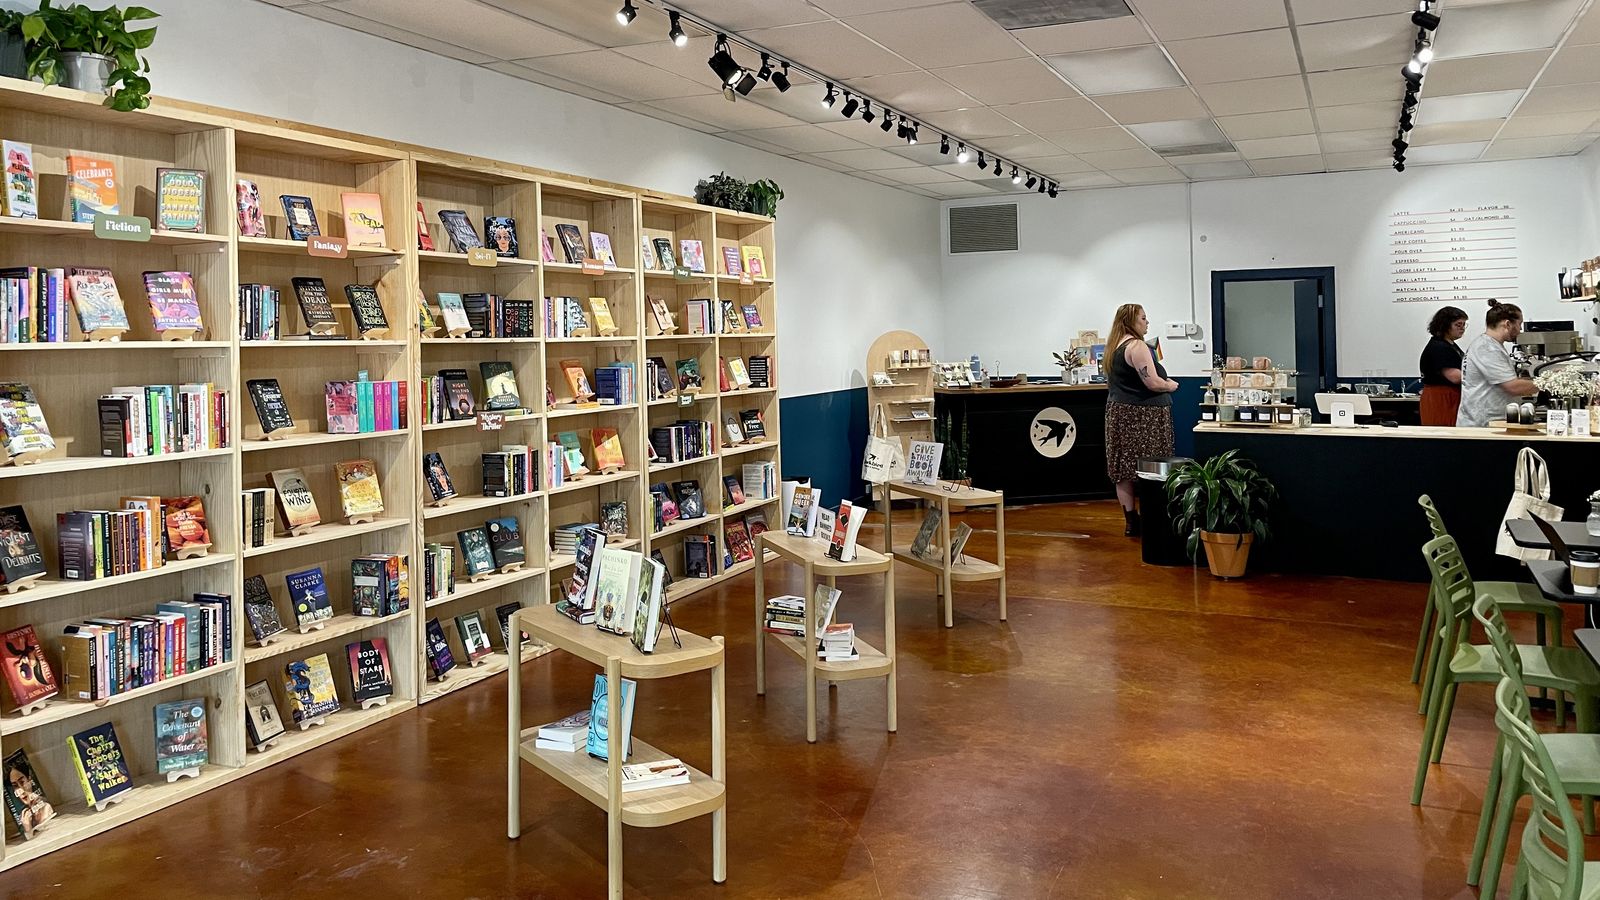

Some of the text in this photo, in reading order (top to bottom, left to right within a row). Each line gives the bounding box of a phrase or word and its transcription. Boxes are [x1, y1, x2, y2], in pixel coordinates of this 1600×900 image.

[76, 168, 113, 179] CELEBRANTS
[162, 188, 200, 197] DIGGERS
[106, 220, 141, 232] Fiction
[314, 240, 342, 253] Fantasy
[71, 268, 84, 277] DEEP
[76, 280, 87, 291] RED
[915, 444, 935, 454] GIVE
[283, 488, 308, 497] FOURTH
[286, 495, 311, 506] WING
[820, 521, 832, 532] BANNED
[493, 533, 519, 542] CLUB
[2, 552, 41, 568] DELIGHTS
[602, 554, 628, 565] PACHINKO
[291, 573, 322, 585] SUSANNA
[295, 579, 320, 589] CLARKE
[358, 649, 379, 658] BODY
[360, 665, 383, 674] STARS
[174, 710, 189, 719] The
[162, 720, 200, 732] Covenant
[89, 734, 104, 744] The
[177, 732, 188, 742] of
[86, 741, 115, 755] Cherry
[170, 744, 196, 753] Water
[86, 750, 120, 767] Robbers
[98, 775, 128, 791] Walker
